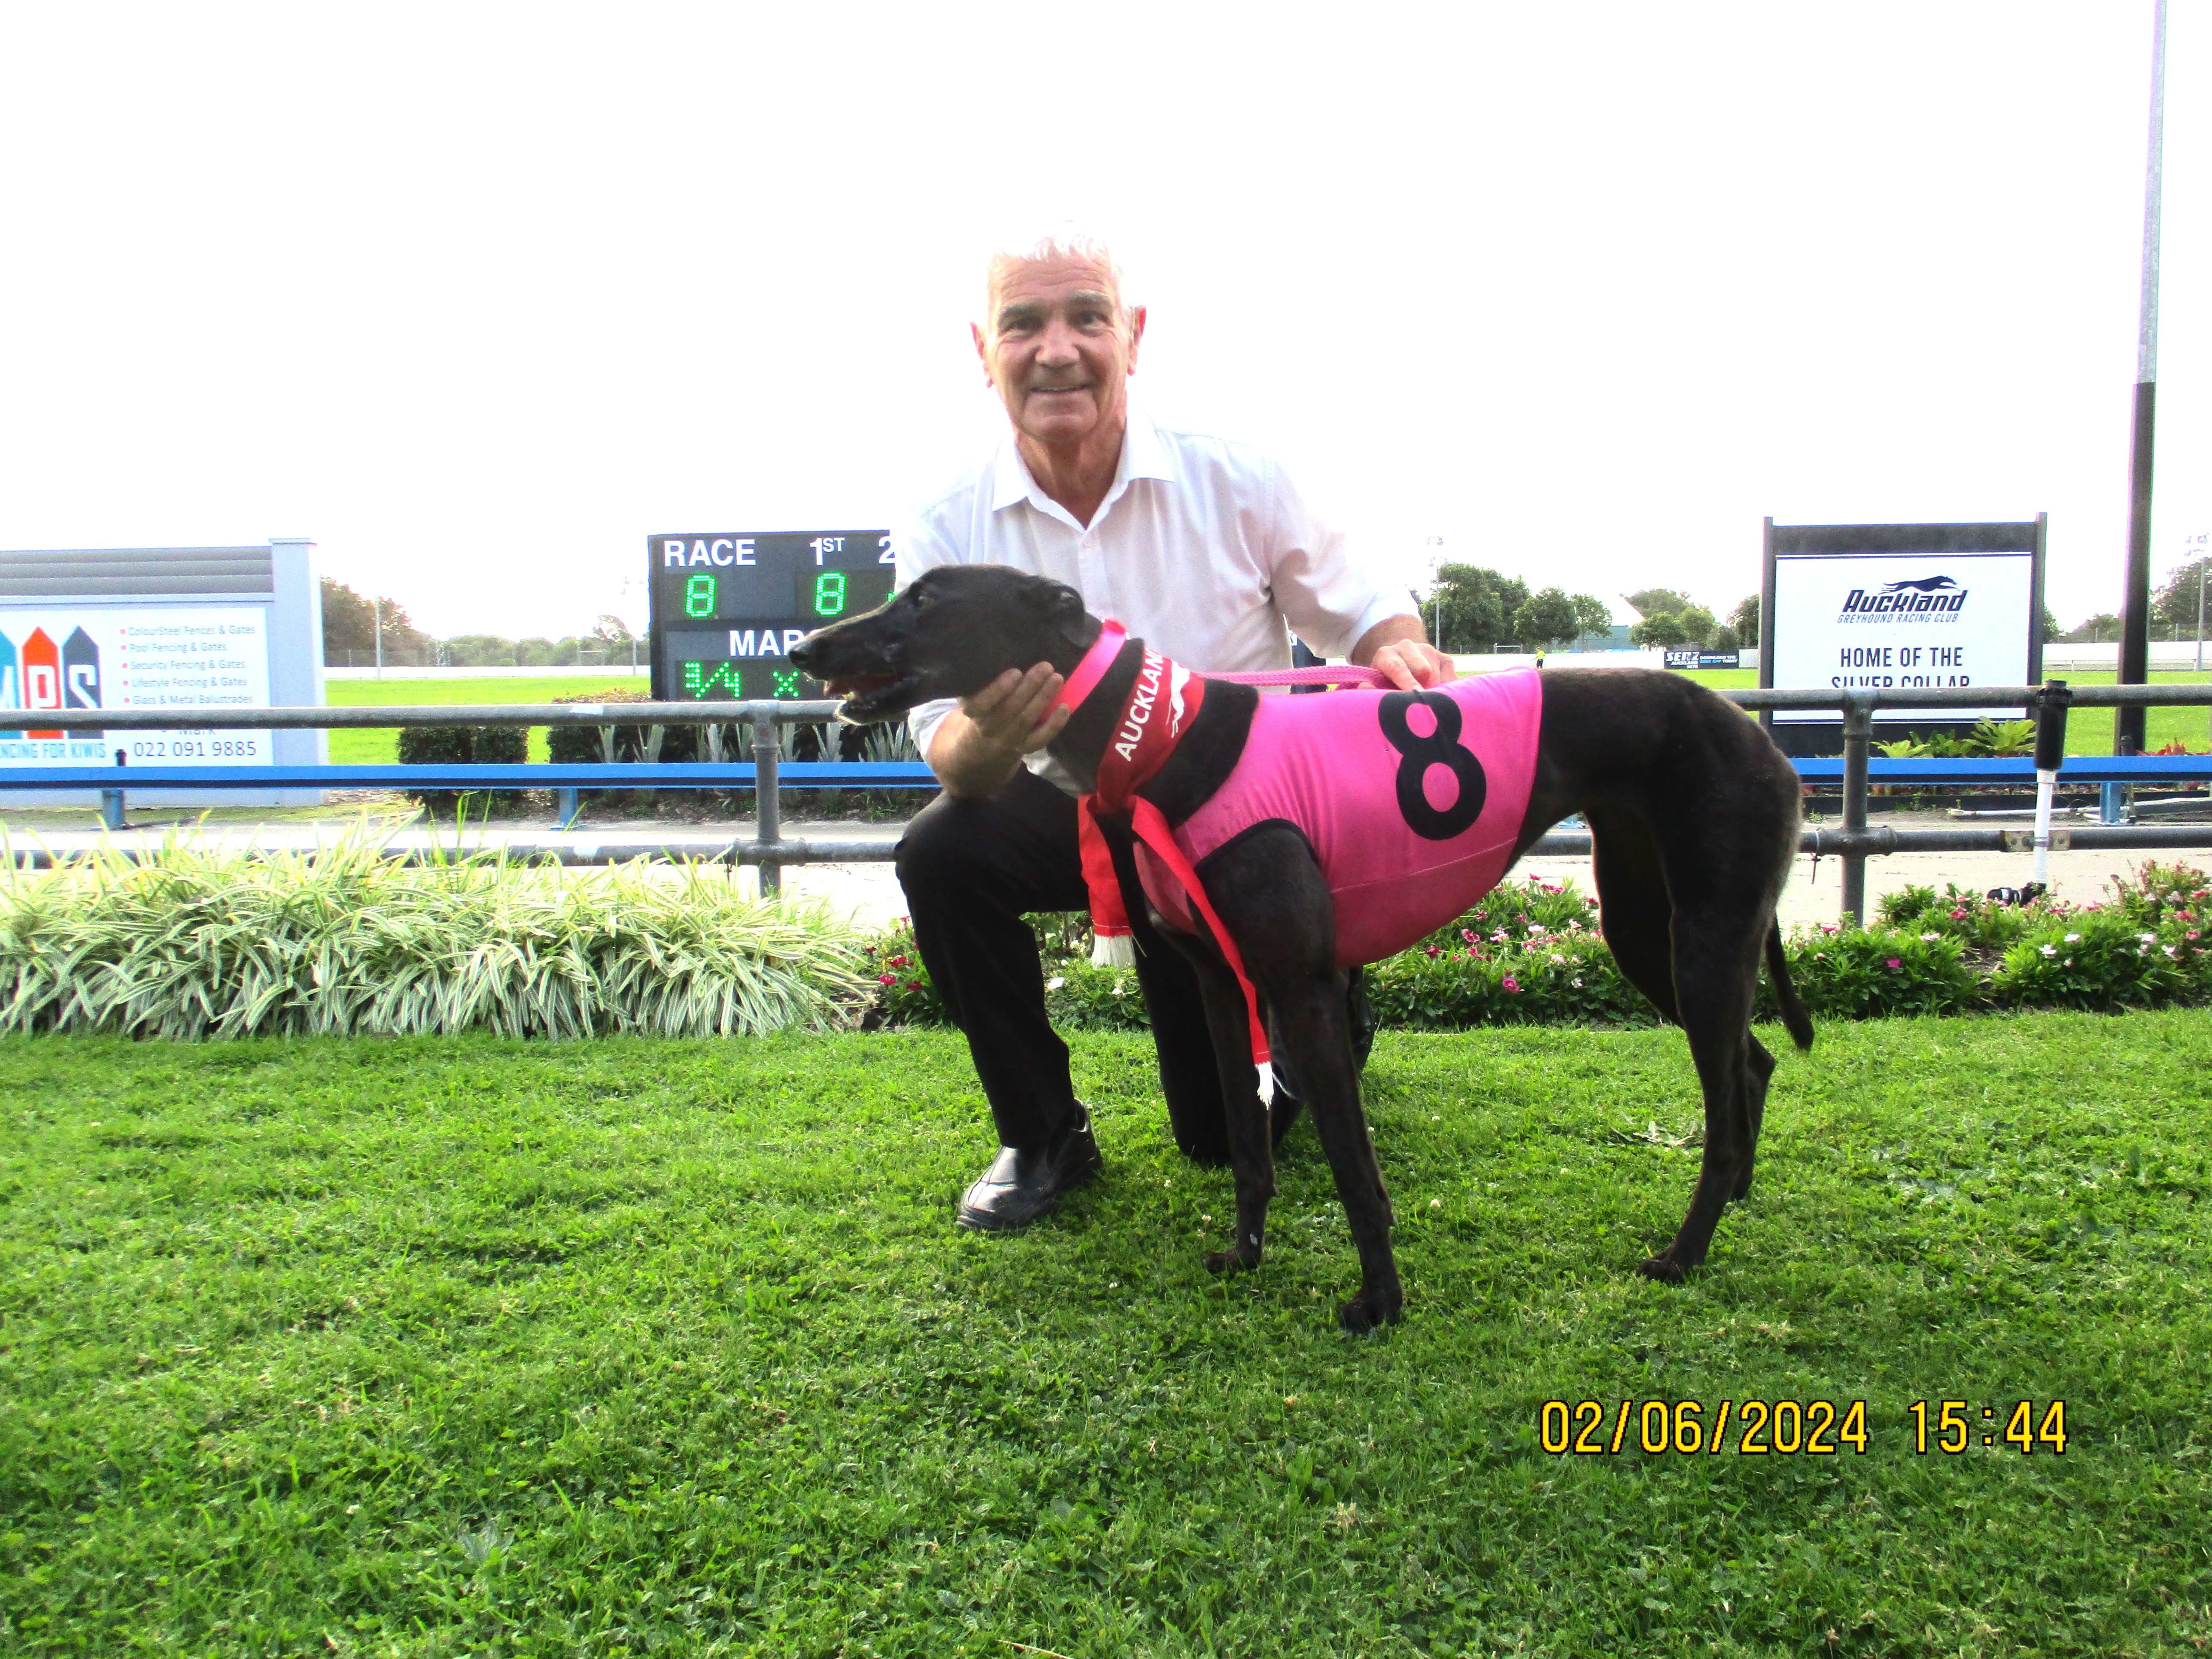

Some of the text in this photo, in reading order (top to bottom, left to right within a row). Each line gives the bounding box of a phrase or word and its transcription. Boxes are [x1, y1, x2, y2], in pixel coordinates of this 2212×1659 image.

[664, 539, 756, 567] RACE
[810, 538, 845, 565] 1ST
[685, 572, 846, 617] 8 8
[1842, 589, 1968, 613] Auckland
[1837, 613, 1959, 623] GREYHOUND RACING CLUB
[185, 626, 216, 635] Fences
[219, 625, 226, 634] &
[229, 625, 255, 634] Gates
[130, 642, 227, 653] Pool Fencing & Gates
[730, 629, 823, 656] MAR
[130, 659, 246, 671] Security Fencing & Gates
[1841, 647, 1963, 667] HOME OF THE
[172, 678, 208, 688] Fencing
[210, 677, 218, 686] &
[220, 677, 247, 686] Gates
[133, 695, 253, 704] Glass & Metal Balustrades
[1115, 647, 1163, 762] AUCKLAN
[43, 743, 67, 758] FOR
[134, 741, 257, 757] 022 091 9885
[1378, 690, 1486, 841] 8
